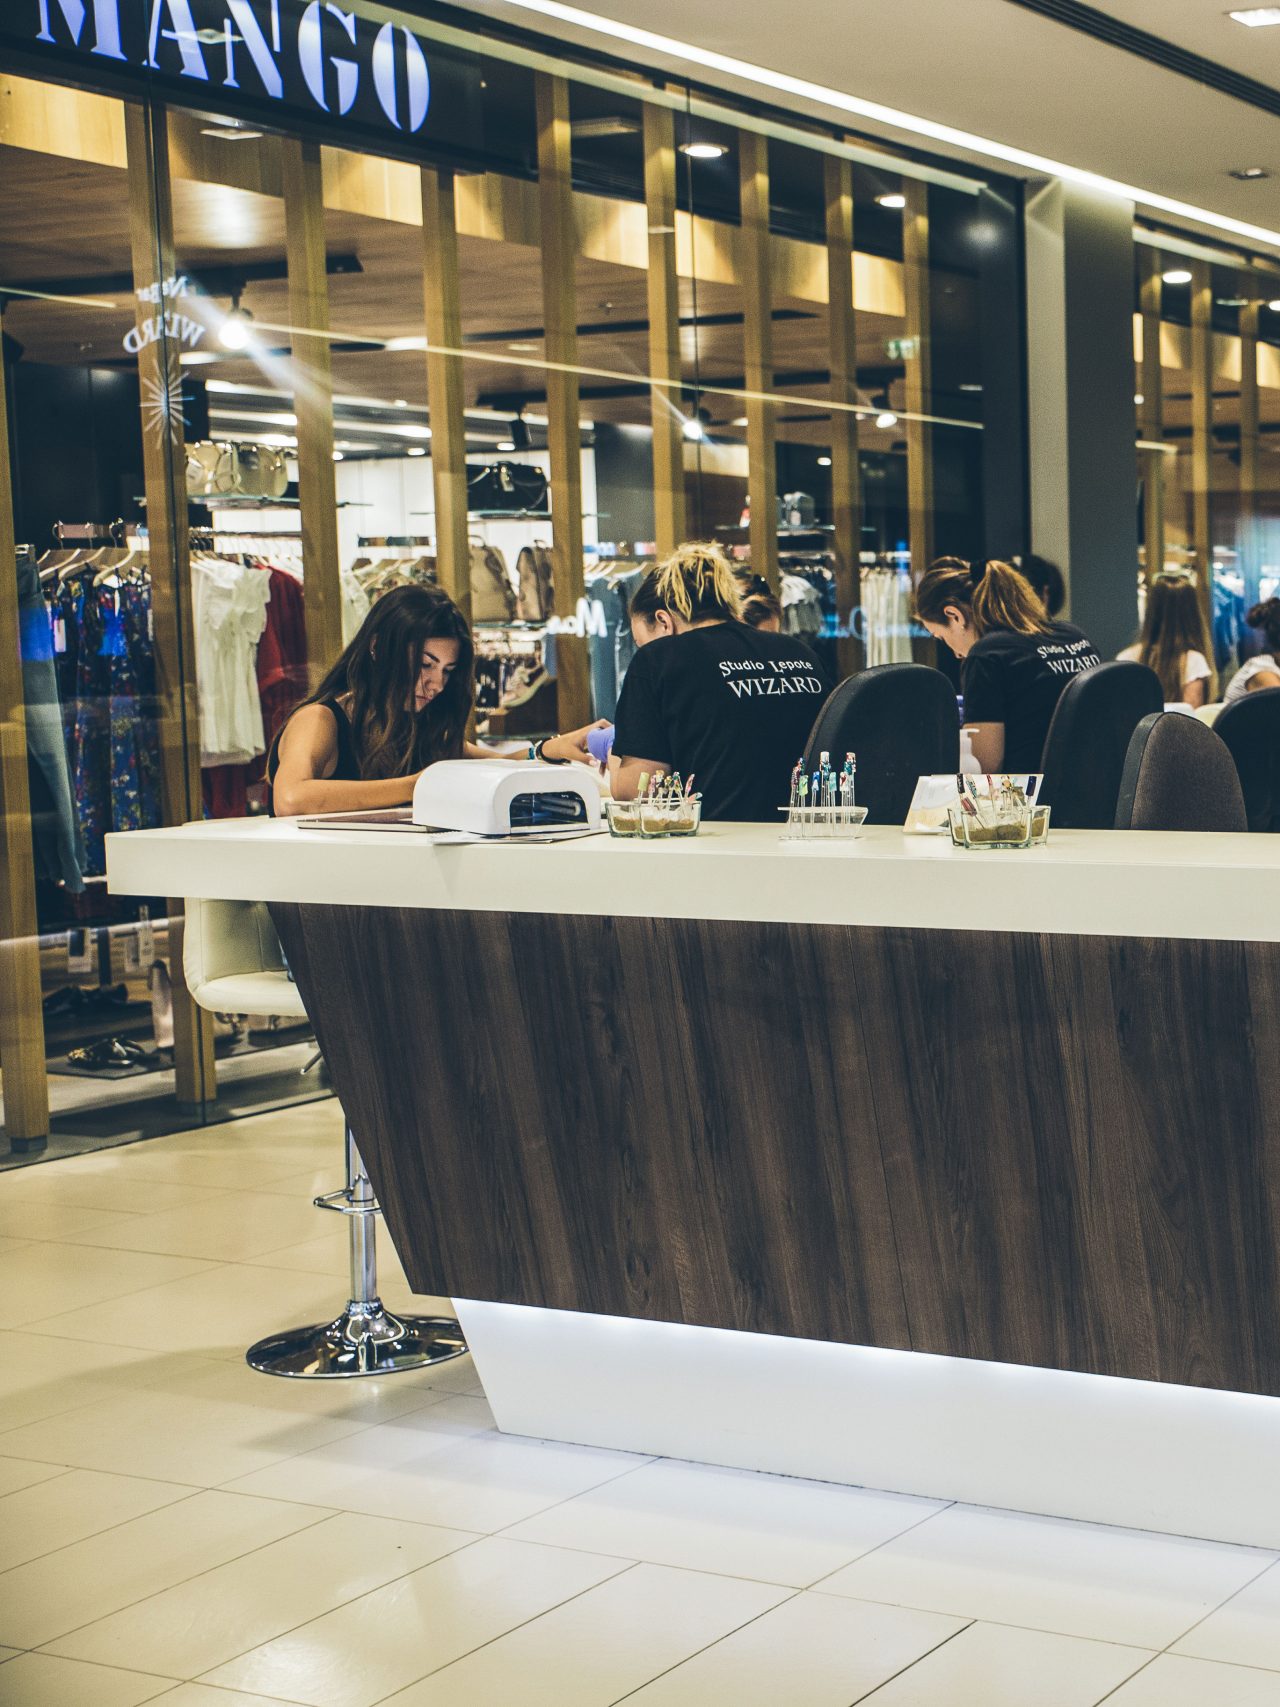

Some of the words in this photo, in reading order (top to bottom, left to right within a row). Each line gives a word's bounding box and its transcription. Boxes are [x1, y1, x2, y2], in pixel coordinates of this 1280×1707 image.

[718, 660, 765, 678] Studio
[767, 660, 814, 674] Lepote
[1046, 654, 1101, 674] WIZARD
[727, 677, 822, 699] WIZARD
